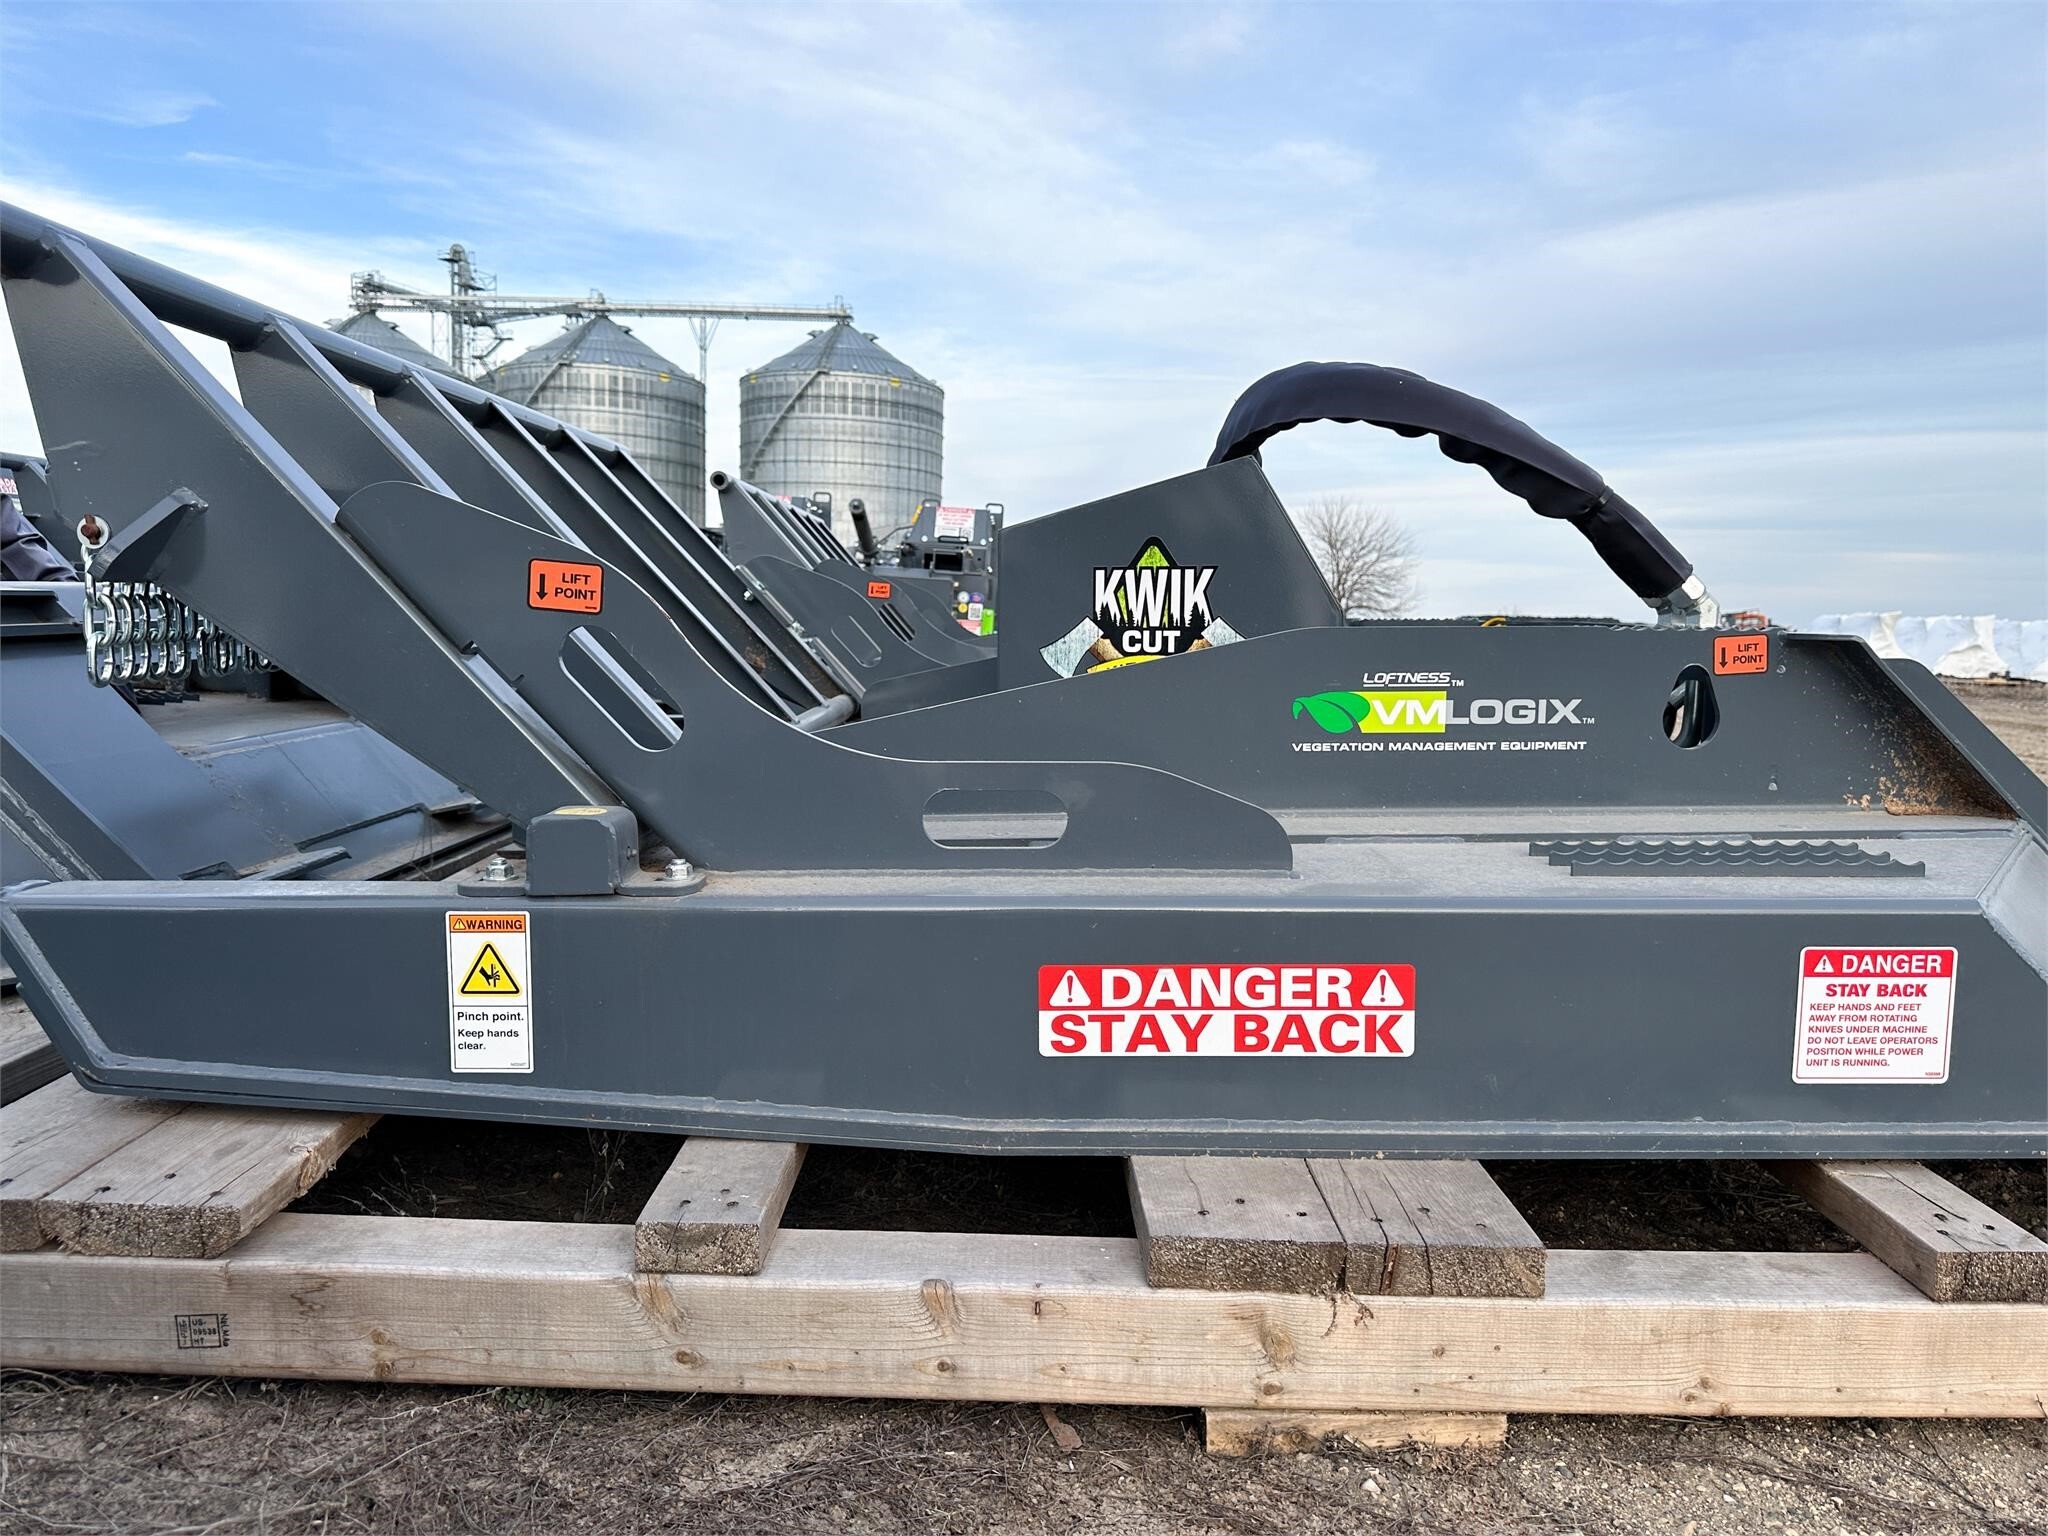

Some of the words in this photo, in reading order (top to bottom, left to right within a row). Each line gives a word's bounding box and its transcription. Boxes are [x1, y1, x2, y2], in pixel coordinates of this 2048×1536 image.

[562, 572, 591, 585] LIFT
[555, 587, 597, 601] POINT
[1095, 568, 1215, 627] KWIK
[1122, 630, 1181, 653] CUT
[1737, 643, 1760, 652] LIFT
[1733, 654, 1764, 664] POINT
[1363, 672, 1452, 687] LOFTNESS
[1291, 742, 1384, 752] VEGETATION
[1388, 742, 1496, 751] MANAGEMENT
[1500, 741, 1587, 751] EQUIPMENT
[466, 919, 523, 930] WARNING
[1842, 955, 1942, 974] DANGER
[1101, 967, 1353, 1009] DANGER
[1825, 983, 1871, 997] STAY
[1876, 983, 1928, 997] BACK
[1809, 1003, 1836, 1011] KEEP
[1837, 1003, 1872, 1011] HANDS
[1873, 1003, 1895, 1011] AND
[1897, 1003, 1922, 1011] FEET
[457, 1012, 489, 1021] Pinch
[492, 1012, 524, 1023] point.
[1809, 1014, 1836, 1022] AWAY
[1838, 1014, 1867, 1022] FROM
[1870, 1014, 1918, 1022] ROTATING
[457, 1029, 484, 1039] Keep
[487, 1029, 519, 1037] hands
[1050, 1014, 1214, 1053] STAY
[1233, 1014, 1404, 1053] BACK
[458, 1041, 487, 1050] clear.
[1807, 1037, 1822, 1045] DO
[1824, 1037, 1845, 1045] NOT
[1847, 1037, 1877, 1045] LEAVE
[1880, 1037, 1938, 1045] OPERATORS
[1807, 1048, 1852, 1056] POSITION
[1854, 1048, 1885, 1056] WHILE
[1888, 1048, 1924, 1056] POWER
